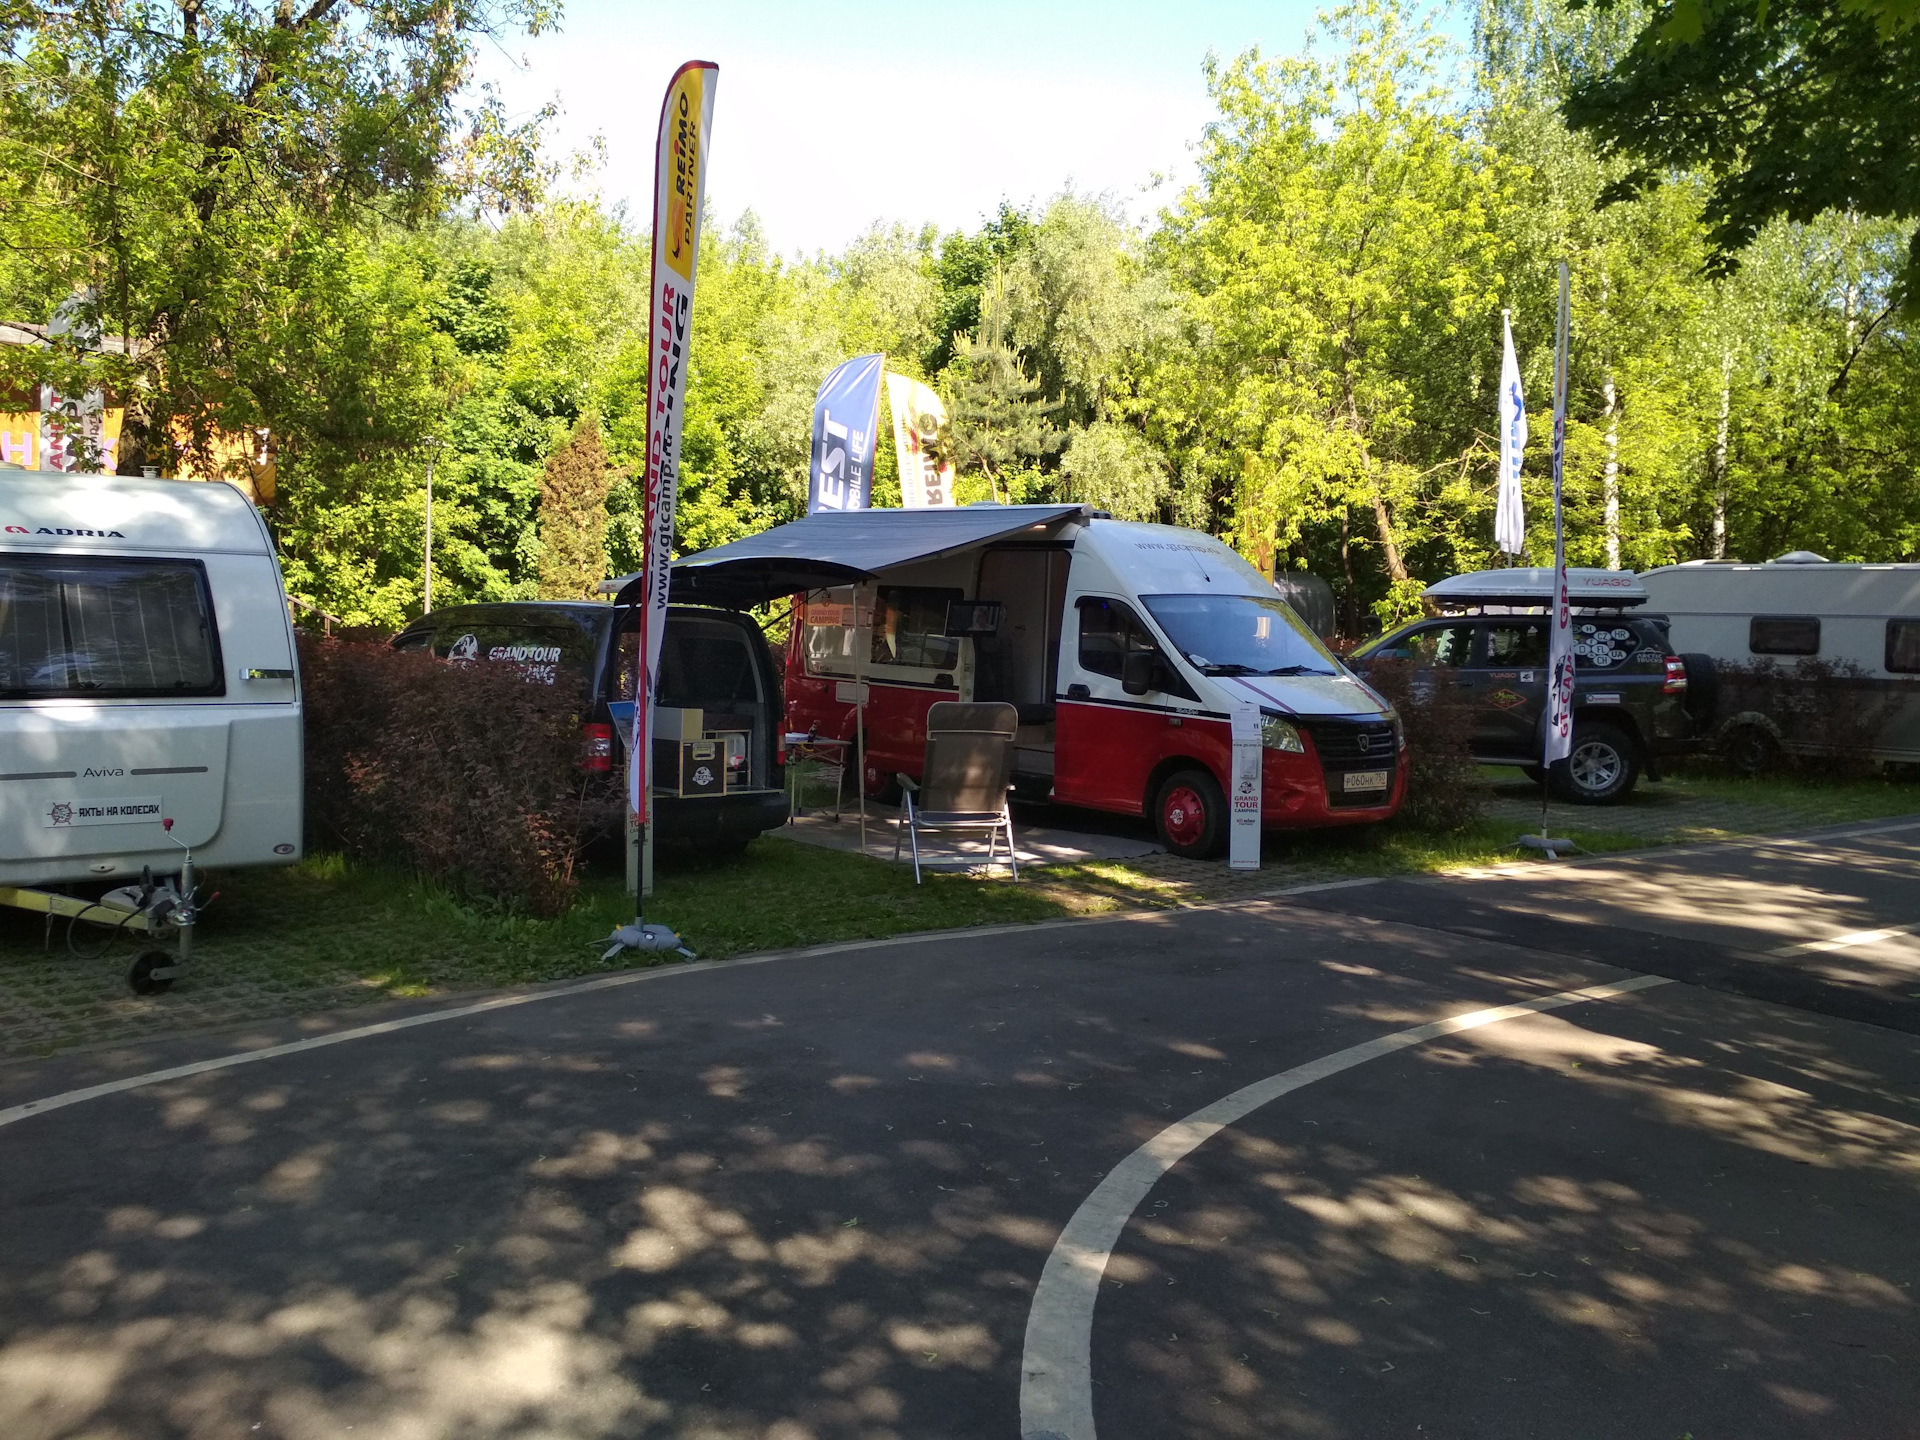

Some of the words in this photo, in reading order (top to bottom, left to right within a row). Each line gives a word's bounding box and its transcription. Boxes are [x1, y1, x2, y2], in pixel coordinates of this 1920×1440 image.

[674, 91, 689, 197] REIMO
[684, 120, 697, 246] PARTNER
[648, 430, 662, 543] AND
[656, 282, 675, 420] TOUR
[851, 429, 864, 463] LIFE
[818, 409, 848, 510] EST
[657, 434, 675, 610] www.gtcamp.ru
[36, 527, 126, 539] ADRIA
[1134, 542, 1221, 555] www.gtcamp.ru
[1583, 577, 1632, 587] YUAGO
[810, 616, 840, 624] CAMPING
[1597, 632, 1608, 640] CZ
[1614, 630, 1626, 638] HR
[488, 646, 529, 661] GRAND
[529, 646, 561, 662] TOUR
[1579, 645, 1586, 654] D
[1597, 656, 1608, 665] CH
[83, 766, 124, 778] Aviva
[79, 807, 105, 818] ЯХТЫ
[106, 806, 118, 816] НА
[120, 804, 160, 815] КОЛЕСАХ
[1234, 801, 1258, 809] TOUR
